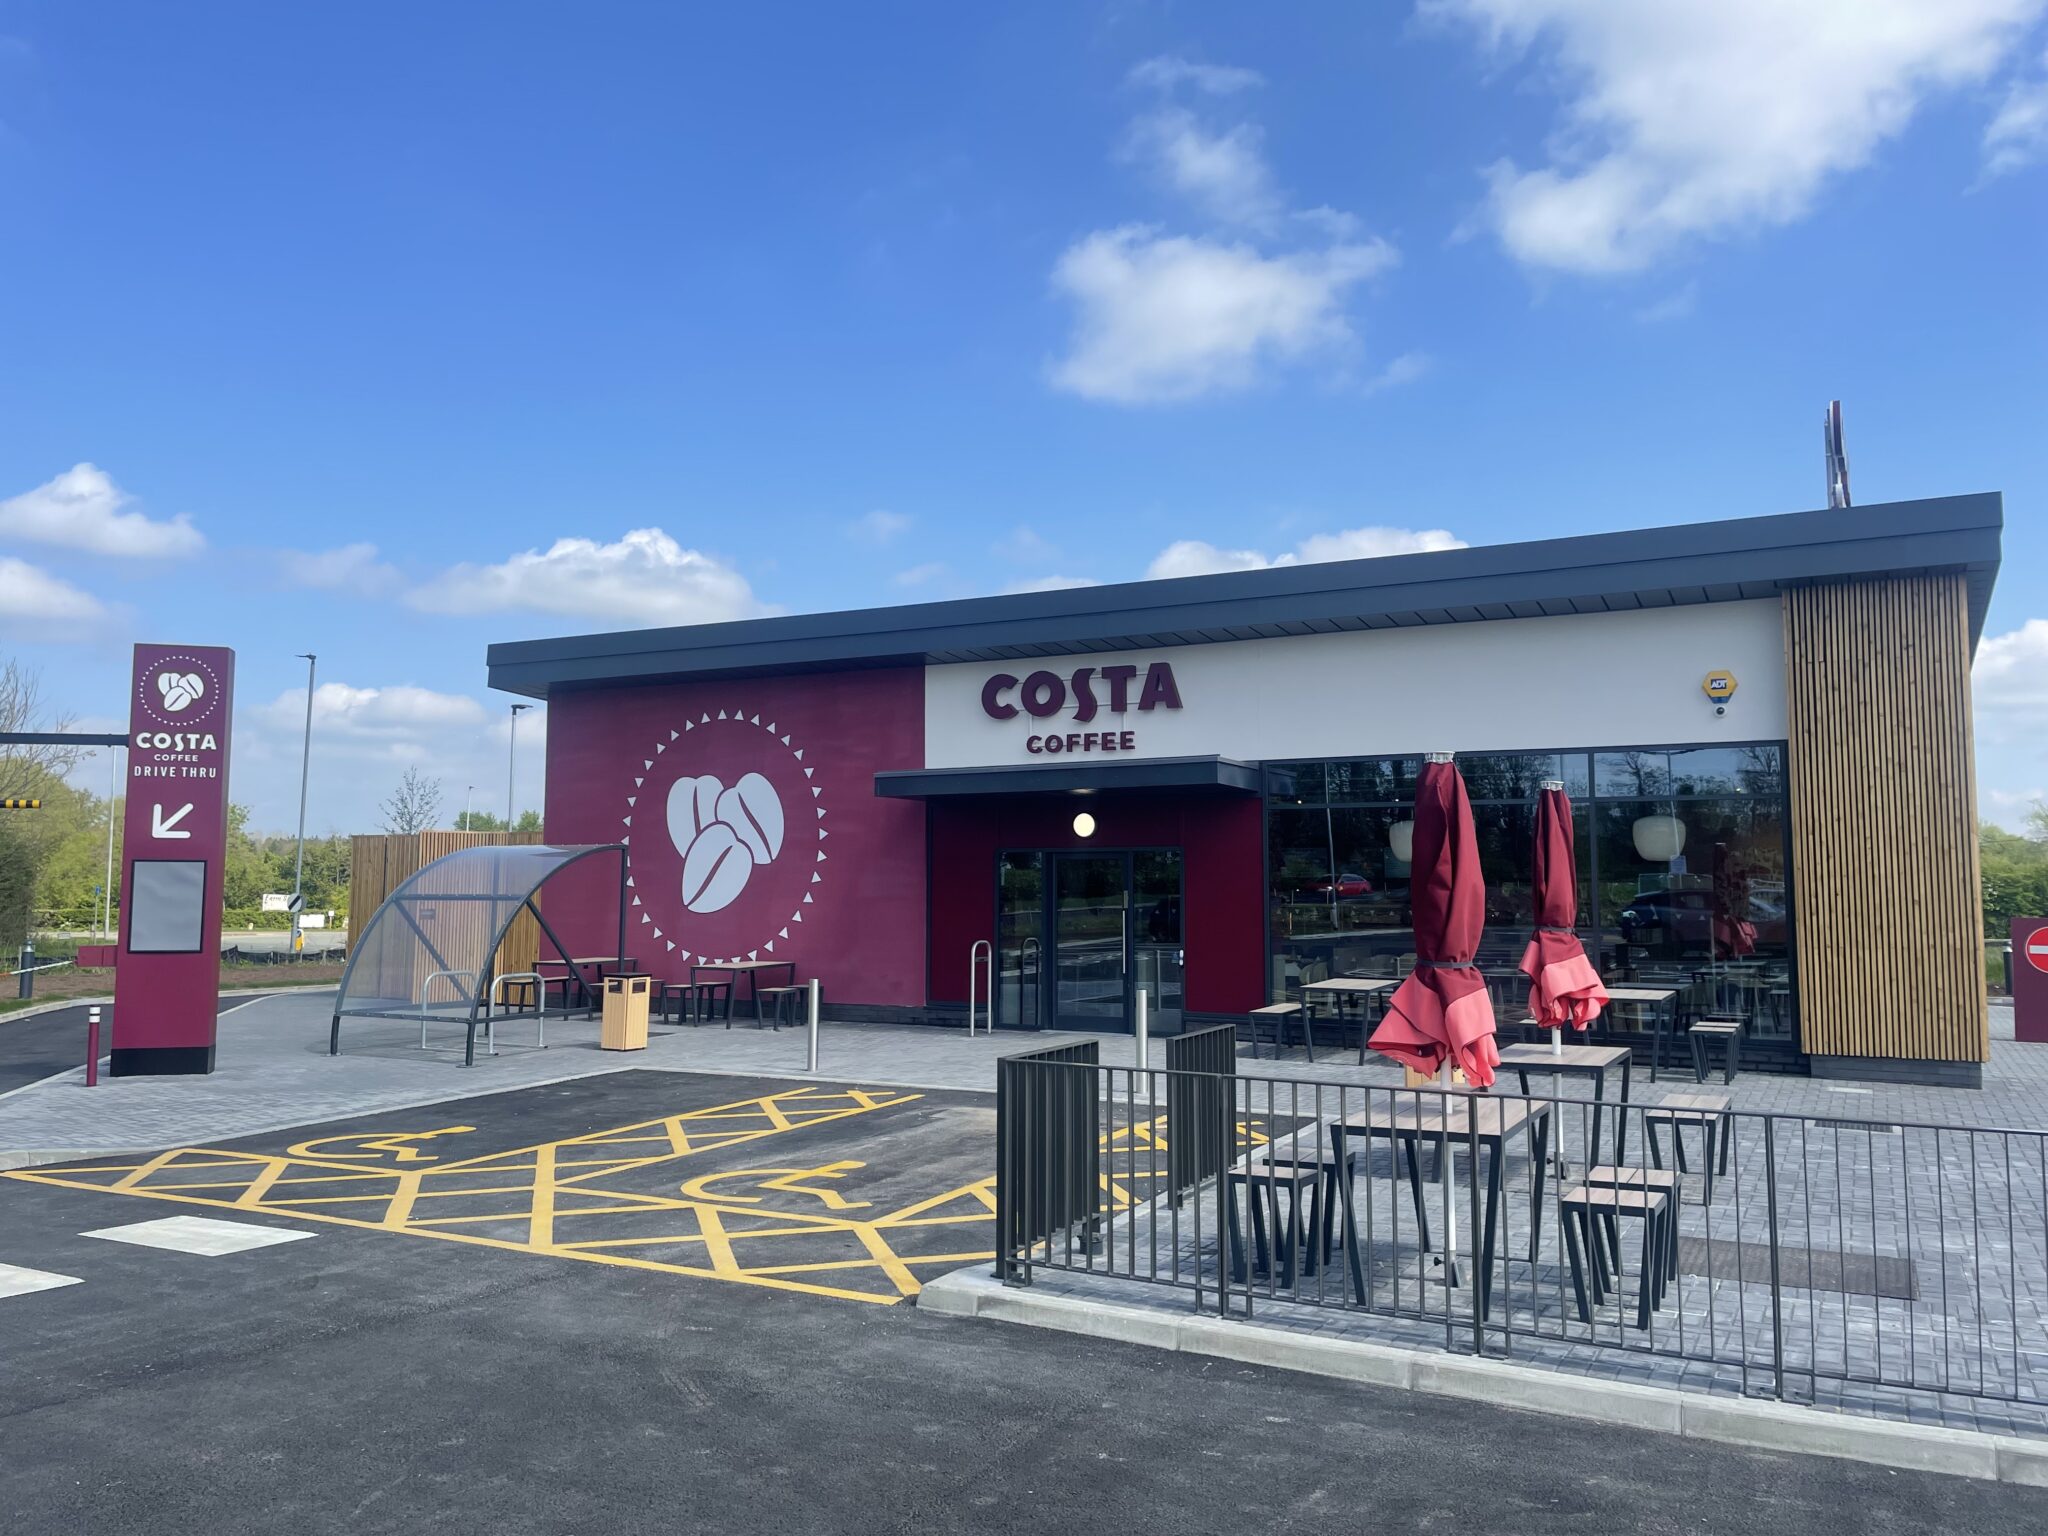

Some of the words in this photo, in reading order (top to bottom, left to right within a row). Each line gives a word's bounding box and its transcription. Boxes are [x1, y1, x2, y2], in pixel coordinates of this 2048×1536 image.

[1711, 679, 1728, 689] ADT
[981, 662, 1183, 723] COSTA
[136, 732, 217, 752] COSTA
[1026, 731, 1136, 754] COFFEE
[153, 754, 199, 762] COFFEE
[134, 765, 176, 777] DRIVE
[181, 767, 216, 778] THRU
